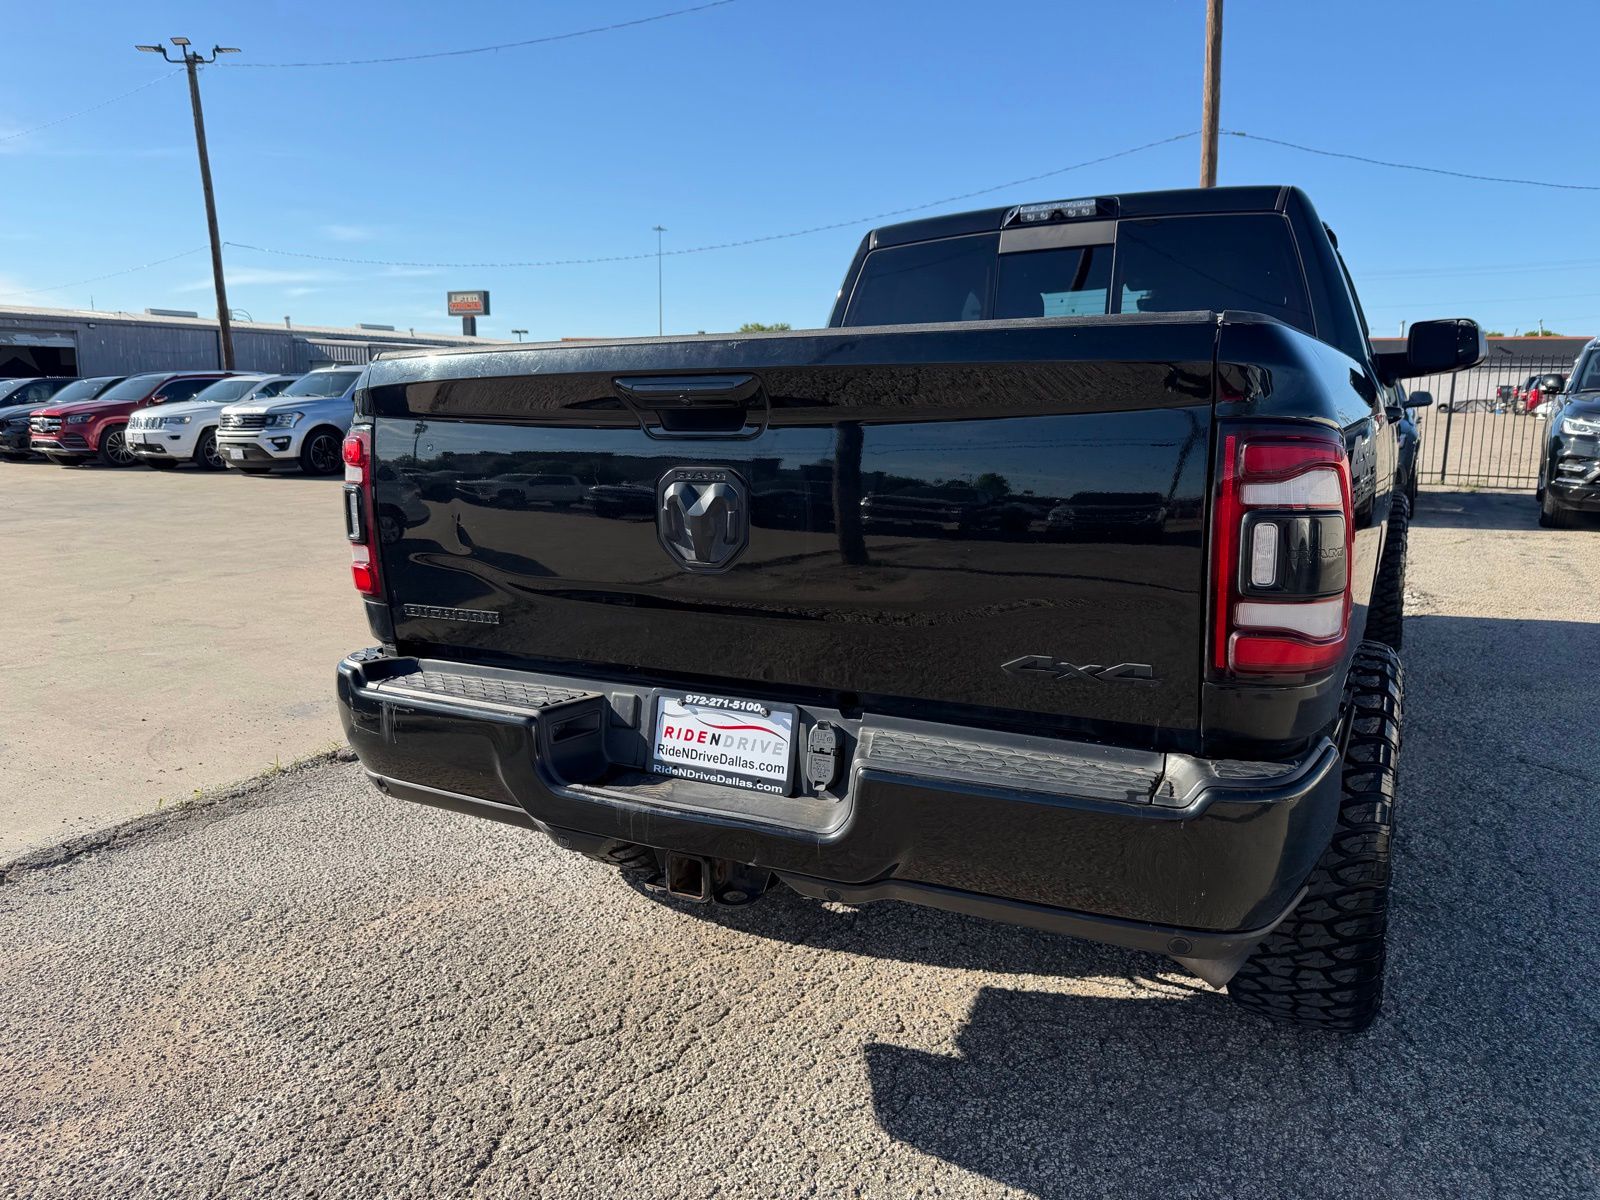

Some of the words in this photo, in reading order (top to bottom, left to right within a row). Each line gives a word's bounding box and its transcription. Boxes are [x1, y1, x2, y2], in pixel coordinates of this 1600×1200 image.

[685, 694, 762, 713] 972-271-5100
[657, 743, 785, 775] RideNDriveDallas.com
[653, 764, 783, 794] RideNDriveDallas.com
